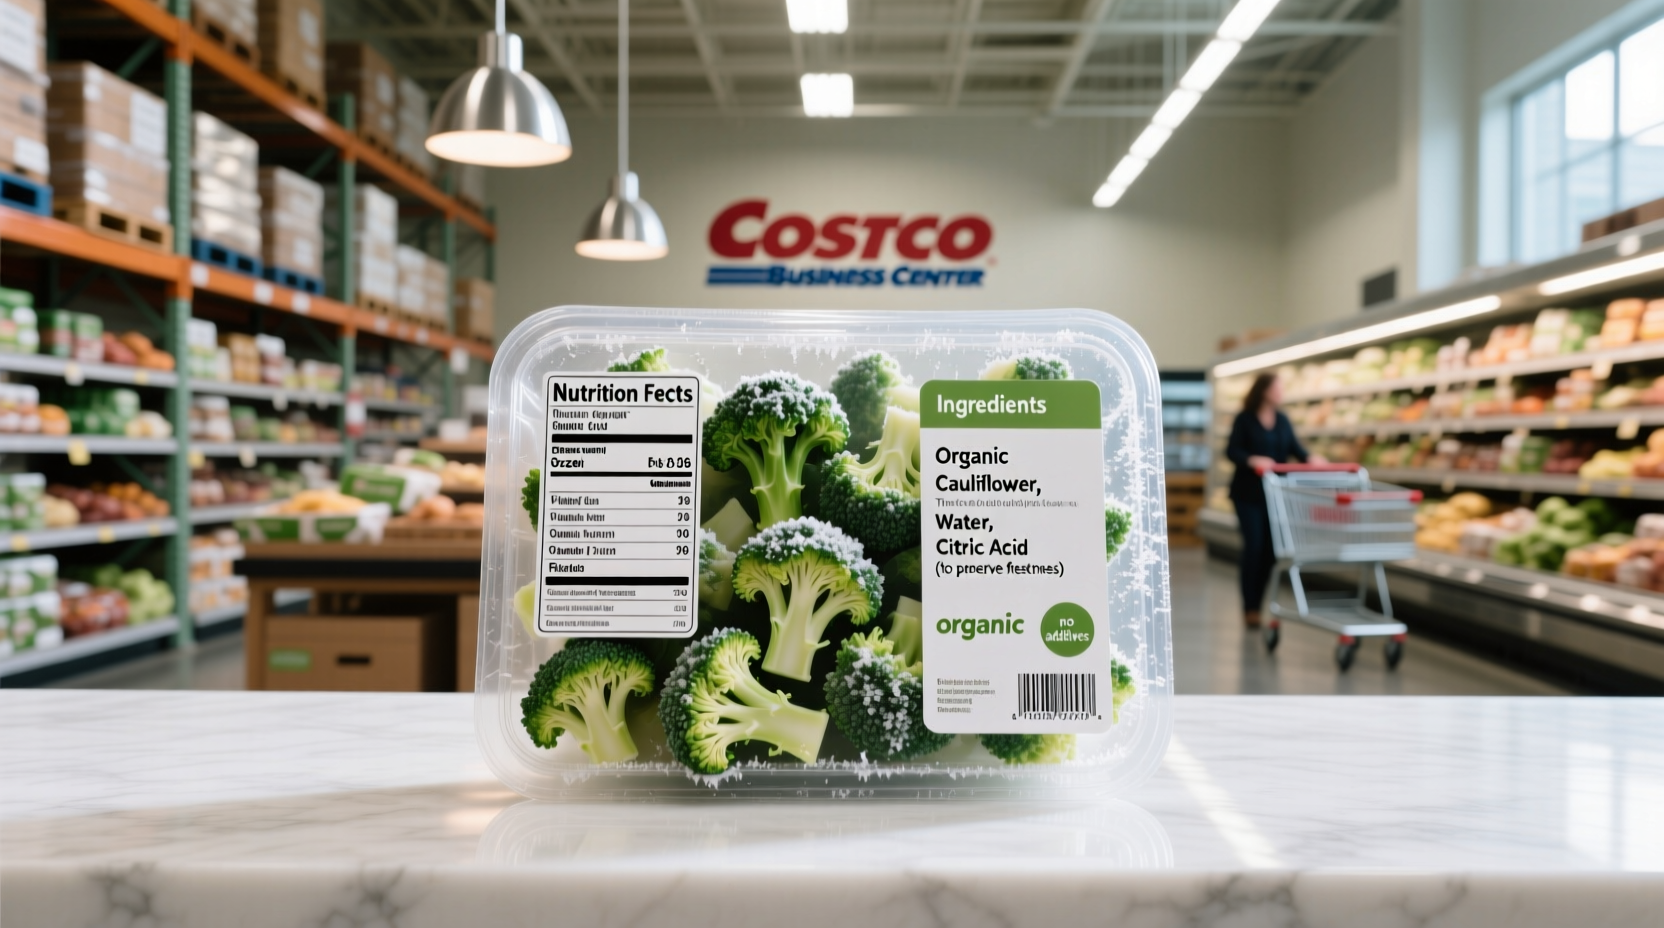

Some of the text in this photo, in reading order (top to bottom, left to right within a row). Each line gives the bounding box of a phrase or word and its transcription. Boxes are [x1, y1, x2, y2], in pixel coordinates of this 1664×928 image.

[891, 264, 985, 287] CENTER
[553, 383, 693, 403] Nutrition Fects
[937, 395, 1047, 418] Ingredients
[935, 447, 1009, 469] Organic
[935, 474, 1042, 497] Cauliflower,
[935, 513, 994, 532] Water,
[936, 537, 1029, 556] Citric Acid
[936, 612, 1025, 641] organic
[1059, 617, 1075, 628] no
